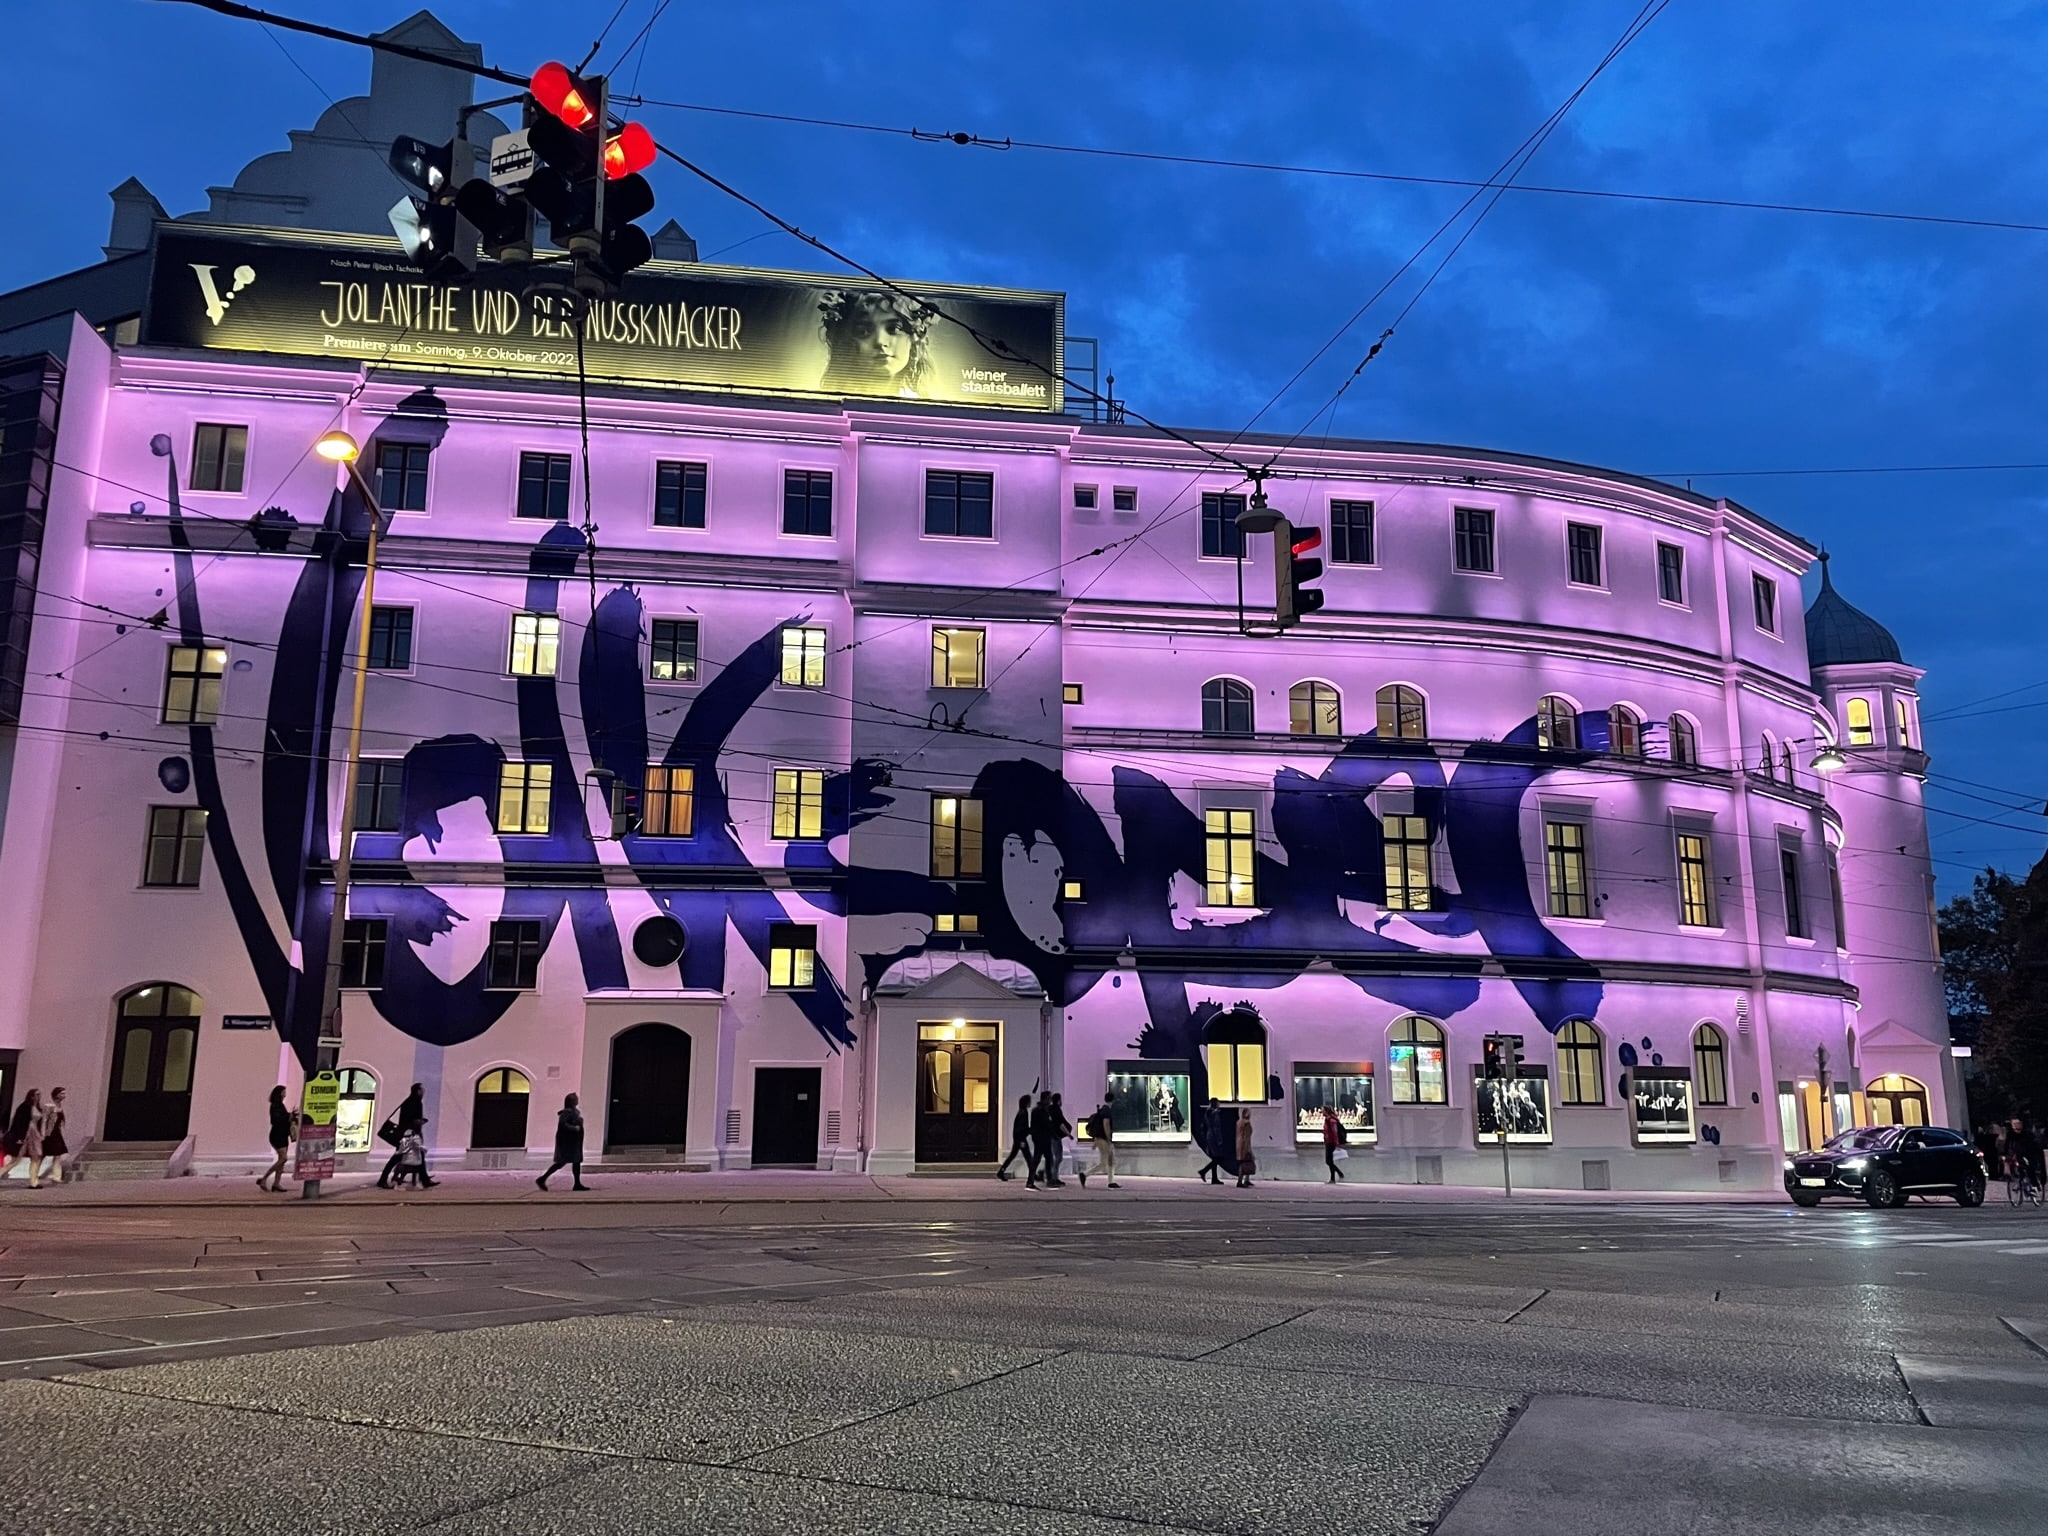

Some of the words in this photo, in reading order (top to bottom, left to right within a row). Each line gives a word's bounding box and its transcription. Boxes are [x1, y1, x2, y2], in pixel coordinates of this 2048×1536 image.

[320, 282, 460, 331] JOLANTHE
[472, 289, 520, 335] UND
[533, 295, 575, 338] DER
[586, 299, 742, 350] NUSSKNACKER
[323, 334, 387, 351] Premiere
[389, 342, 411, 353] am
[415, 342, 468, 360] Sonntag,
[472, 346, 483, 359] 9.
[486, 347, 537, 363] Oktober
[540, 351, 575, 365] 2022
[961, 367, 1007, 382] wiener
[961, 380, 1046, 398] staatsballett
